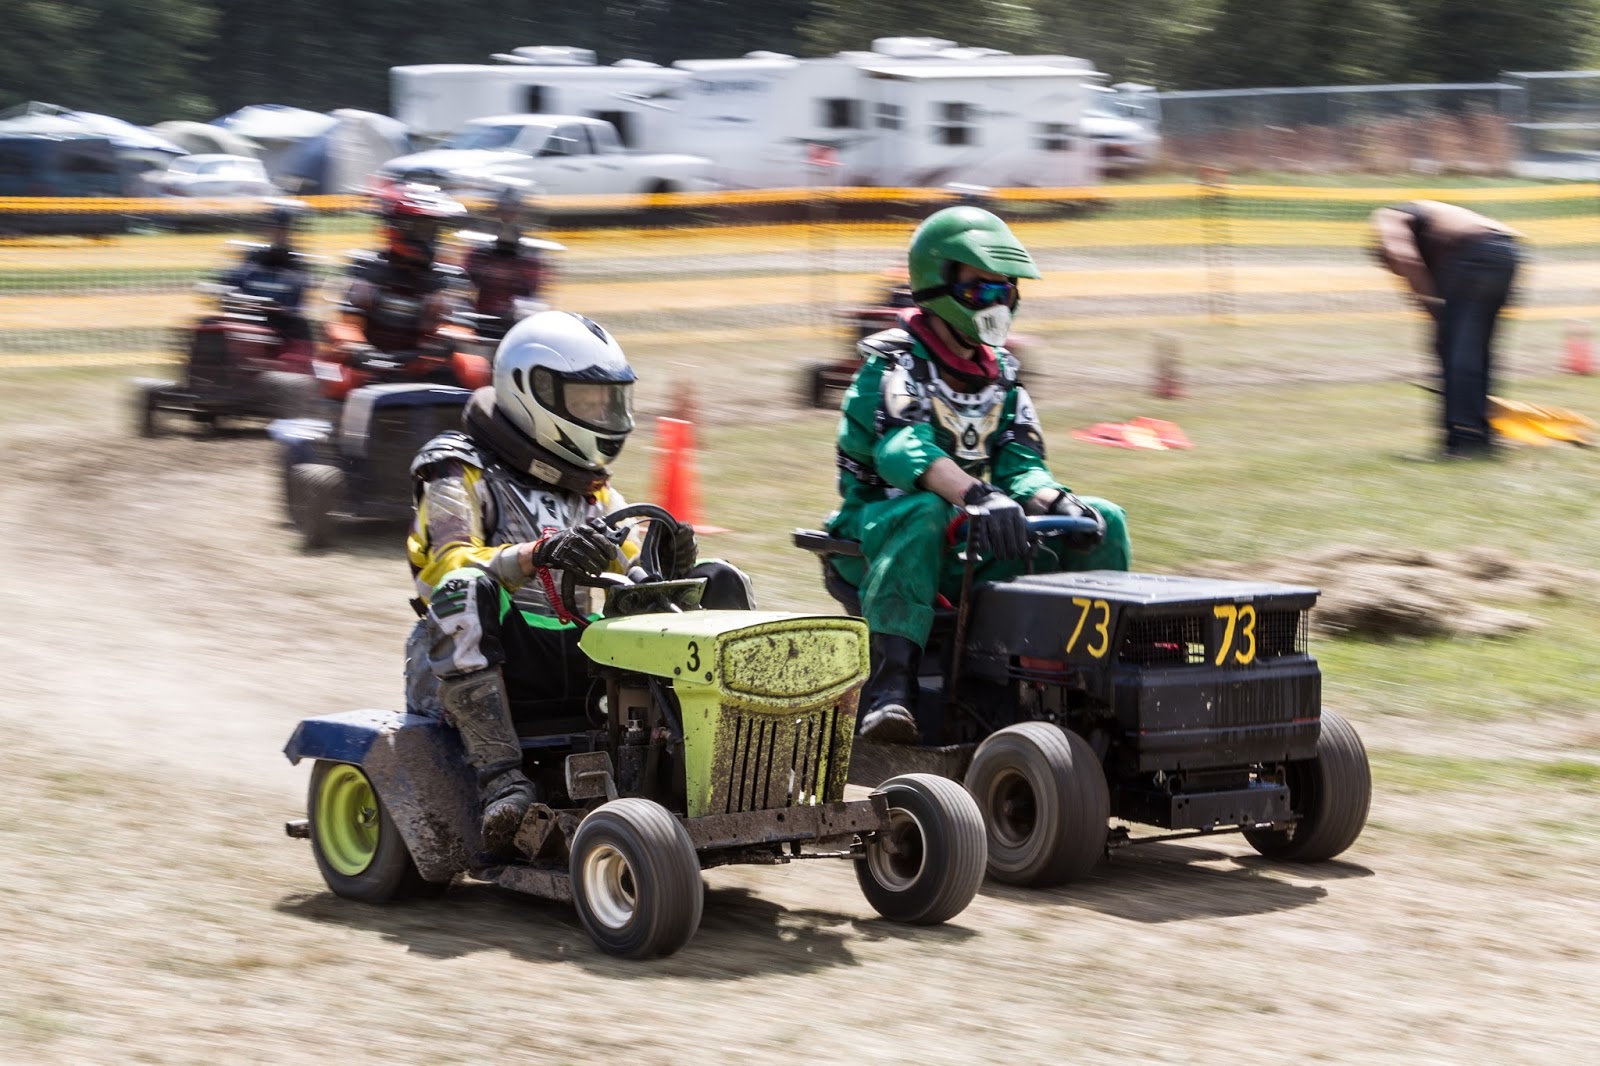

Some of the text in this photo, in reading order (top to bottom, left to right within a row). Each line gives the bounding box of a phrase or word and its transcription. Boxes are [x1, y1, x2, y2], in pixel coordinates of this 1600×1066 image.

[687, 641, 700, 672] 3
[1066, 597, 1110, 658] 73
[1214, 604, 1256, 666] 73
